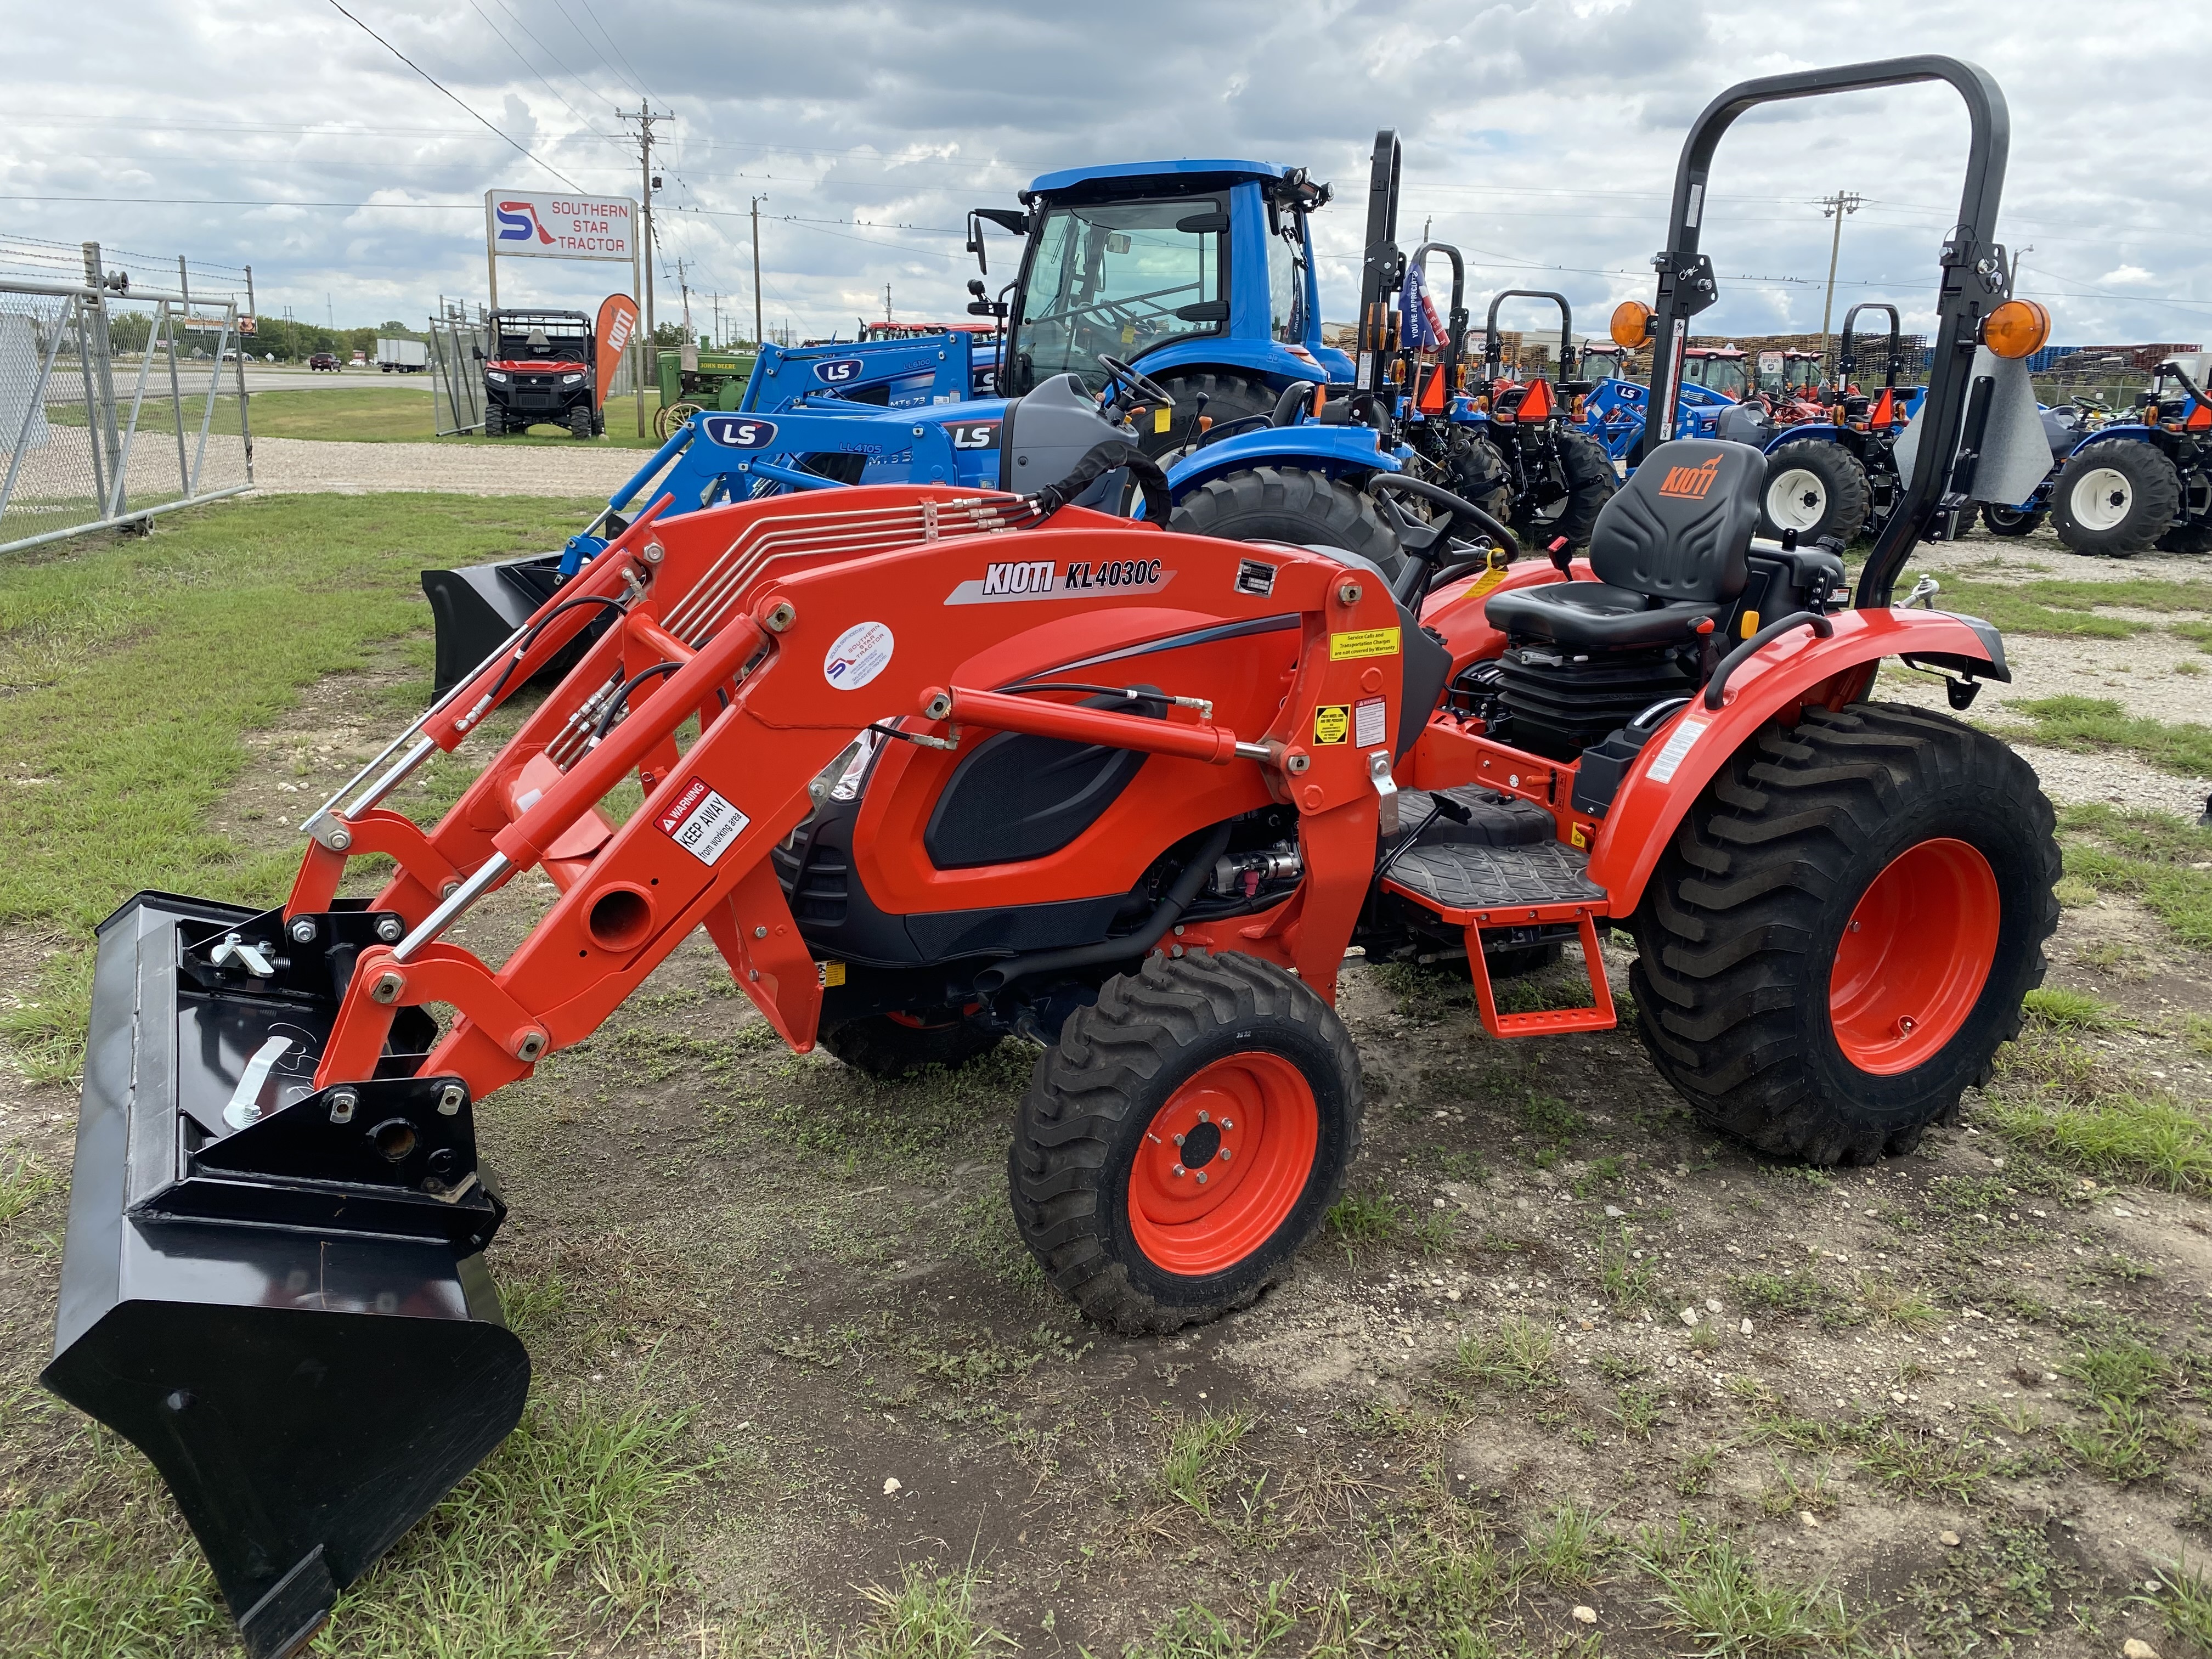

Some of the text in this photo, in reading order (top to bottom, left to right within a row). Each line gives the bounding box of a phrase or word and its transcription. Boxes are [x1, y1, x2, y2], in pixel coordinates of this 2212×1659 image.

[552, 201, 628, 218] SOUTHERN
[573, 219, 608, 234] STAR
[557, 236, 624, 252] TRACTOR
[1410, 270, 1419, 338] YOU'RE APPRECIATD
[607, 308, 634, 353] KIOTI
[827, 364, 850, 380] LS
[903, 358, 931, 370] LL6100
[1620, 387, 1636, 398] LS
[723, 424, 757, 444] LS
[1701, 422, 1713, 432] S
[955, 427, 991, 448] LS
[839, 442, 882, 454] LL4105
[1661, 466, 1718, 495] KIOTI
[983, 558, 1161, 595] KIOTI KL4030C
[848, 624, 880, 653] SOUTHERN
[856, 633, 885, 658] TRACTOR
[859, 635, 875, 650] STAR
[1340, 640, 1373, 648] Transportation
[669, 783, 705, 819] WARNING
[679, 797, 726, 849] KEEP AWAY
[698, 812, 742, 859] from working area
